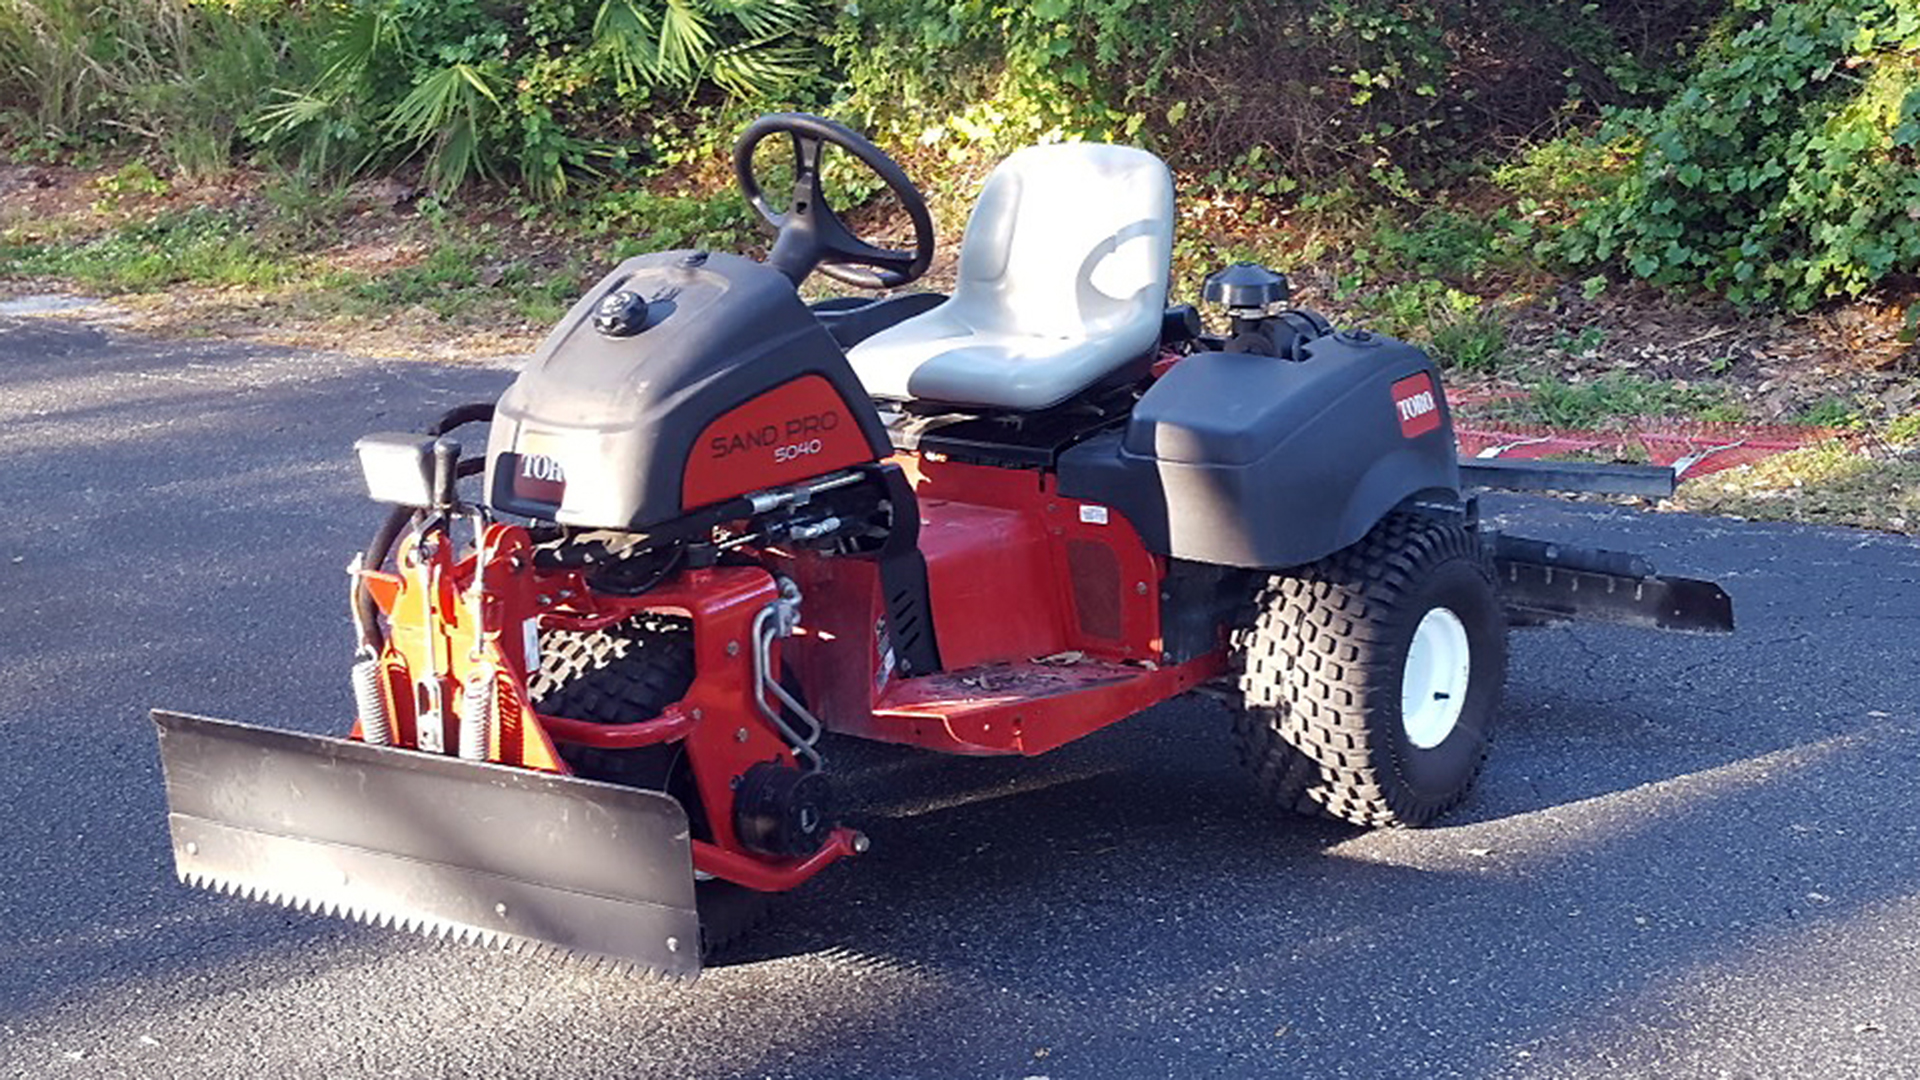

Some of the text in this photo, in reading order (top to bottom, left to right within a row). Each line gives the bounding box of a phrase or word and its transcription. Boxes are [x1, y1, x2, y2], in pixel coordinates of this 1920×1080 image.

[1396, 391, 1436, 421] TORO
[711, 411, 838, 458] SAND PRO
[774, 439, 821, 462] 5040
[521, 454, 565, 482] TOR
